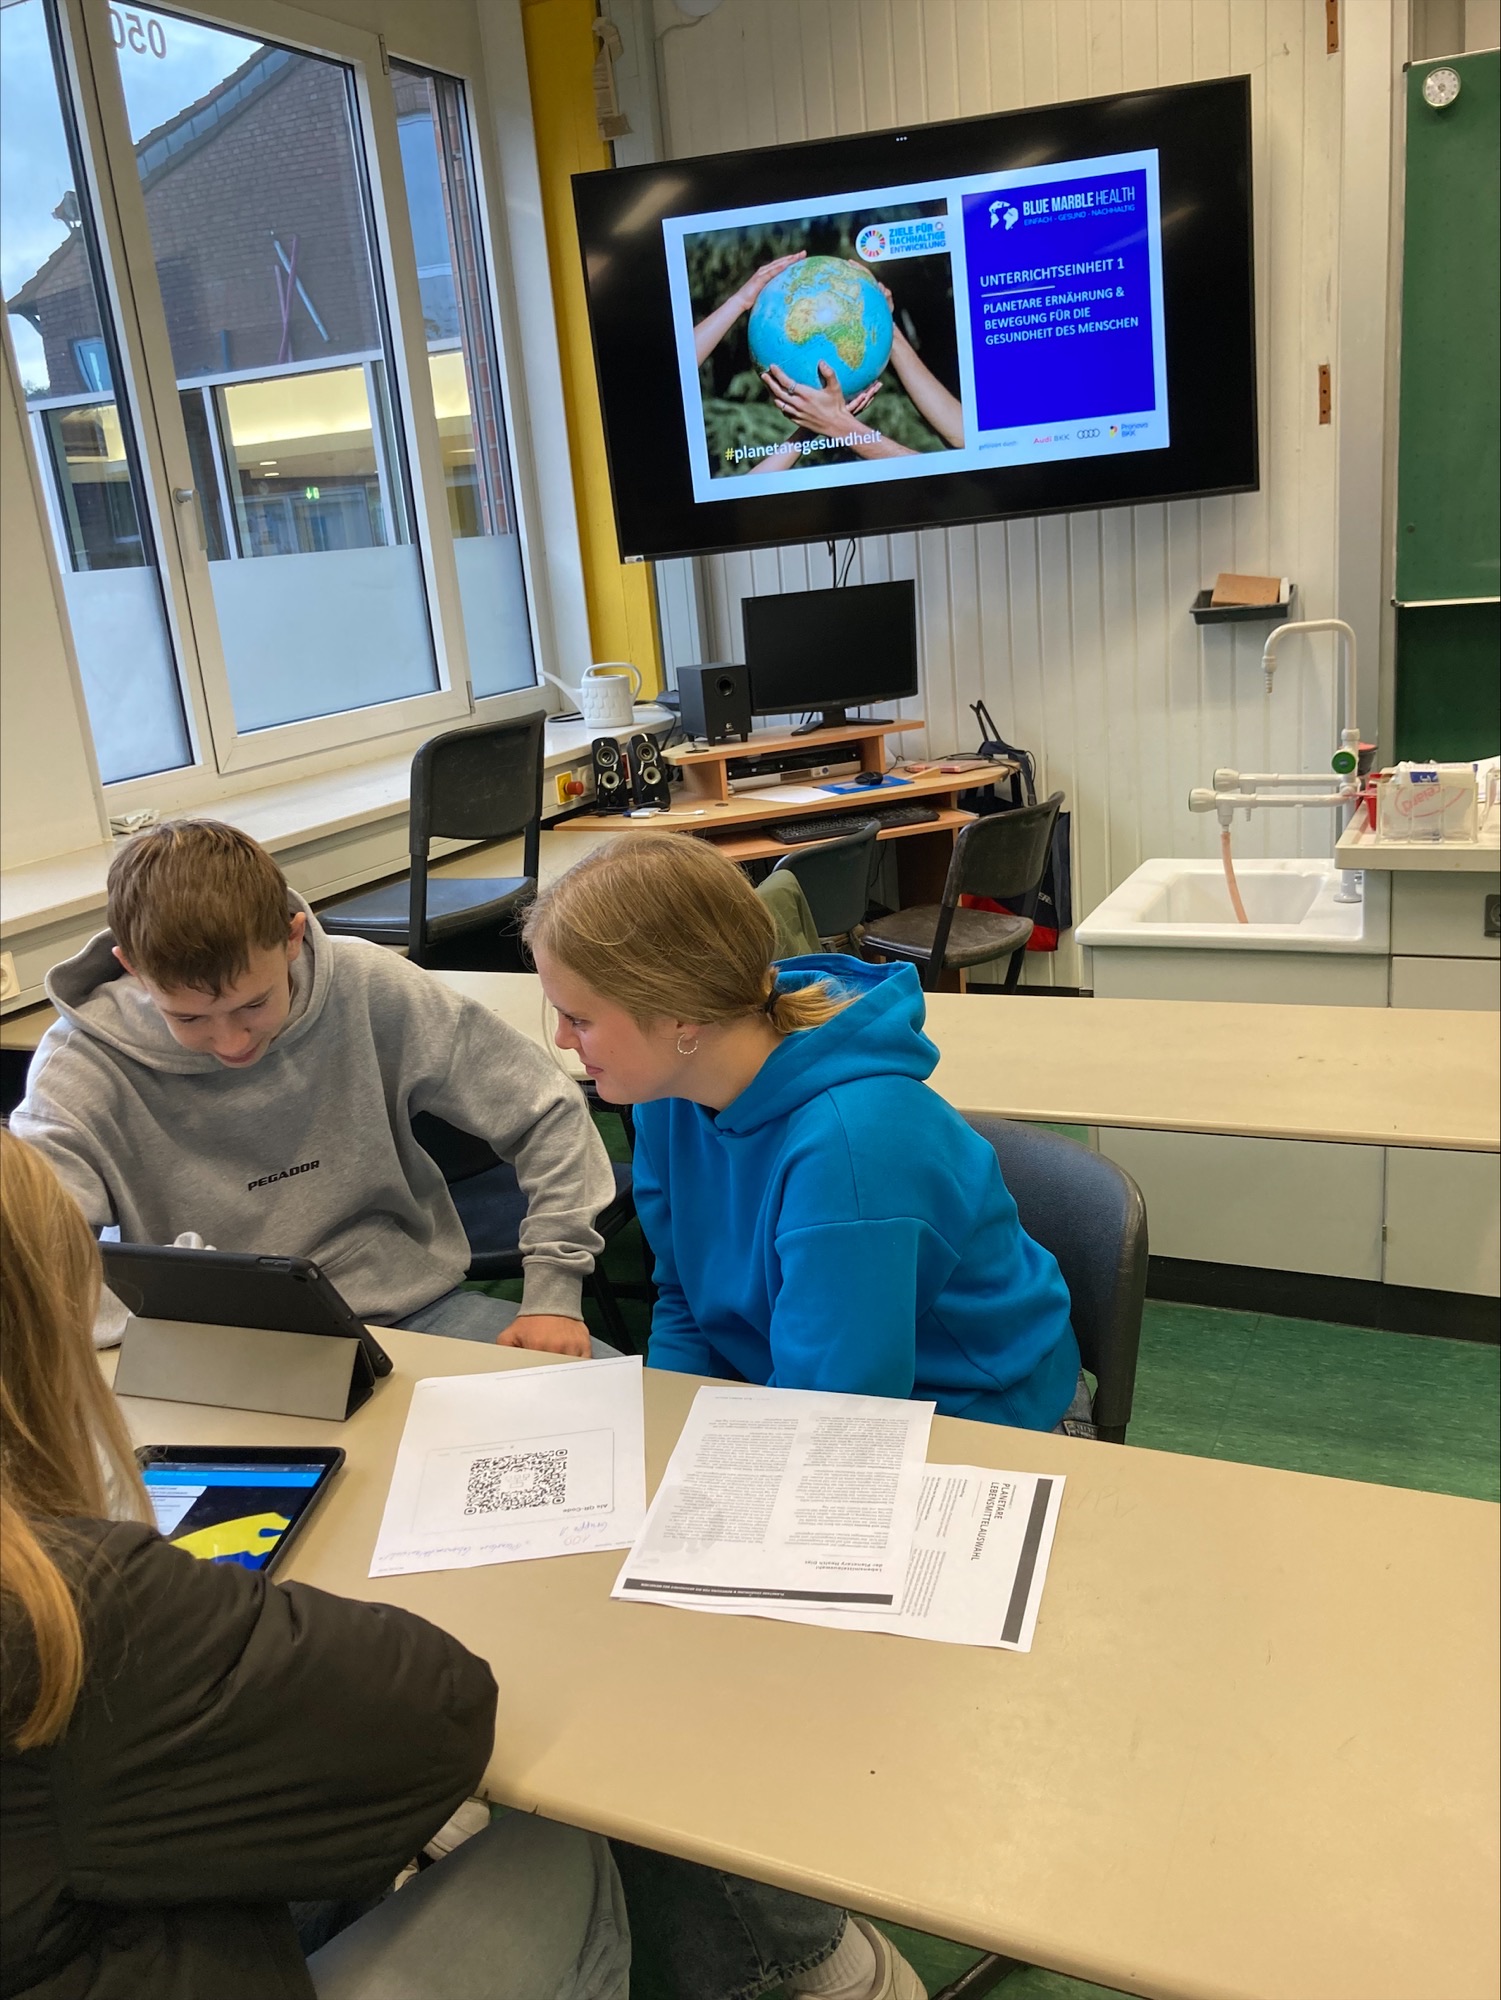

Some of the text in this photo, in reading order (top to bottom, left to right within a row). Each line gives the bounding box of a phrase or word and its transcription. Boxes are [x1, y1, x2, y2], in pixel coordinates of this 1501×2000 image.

[1022, 186, 1136, 216] BLUE MARBLE HEALTH
[1023, 204, 1136, 227] EINFACH GESUND NACHHALTIG
[888, 223, 933, 237] ZIELE FÜR
[889, 231, 946, 245] NACHHALTIGE
[890, 240, 946, 254] ENTWICKLUNG
[980, 257, 1125, 287] UNTERRICHTSEINHEIT 1
[983, 286, 1125, 315] PLANETARE ERNÄHRUNG &
[984, 307, 1091, 330] BEWEGUNG FÜR DIE
[985, 316, 1139, 346] GESUNDHEIT DES MENSCHEN
[725, 430, 882, 463] #planetaregesundheit
[1033, 433, 1070, 444] Audi BKK
[248, 1160, 320, 1191] PEGADOR
[562, 1505, 595, 1513] QR-Code
[994, 1482, 1011, 1520] PLANETARE
[970, 1481, 1000, 1561] LEBENSMITTELAUSWAHL
[815, 1565, 882, 1573] Lebensmittelauswahl
